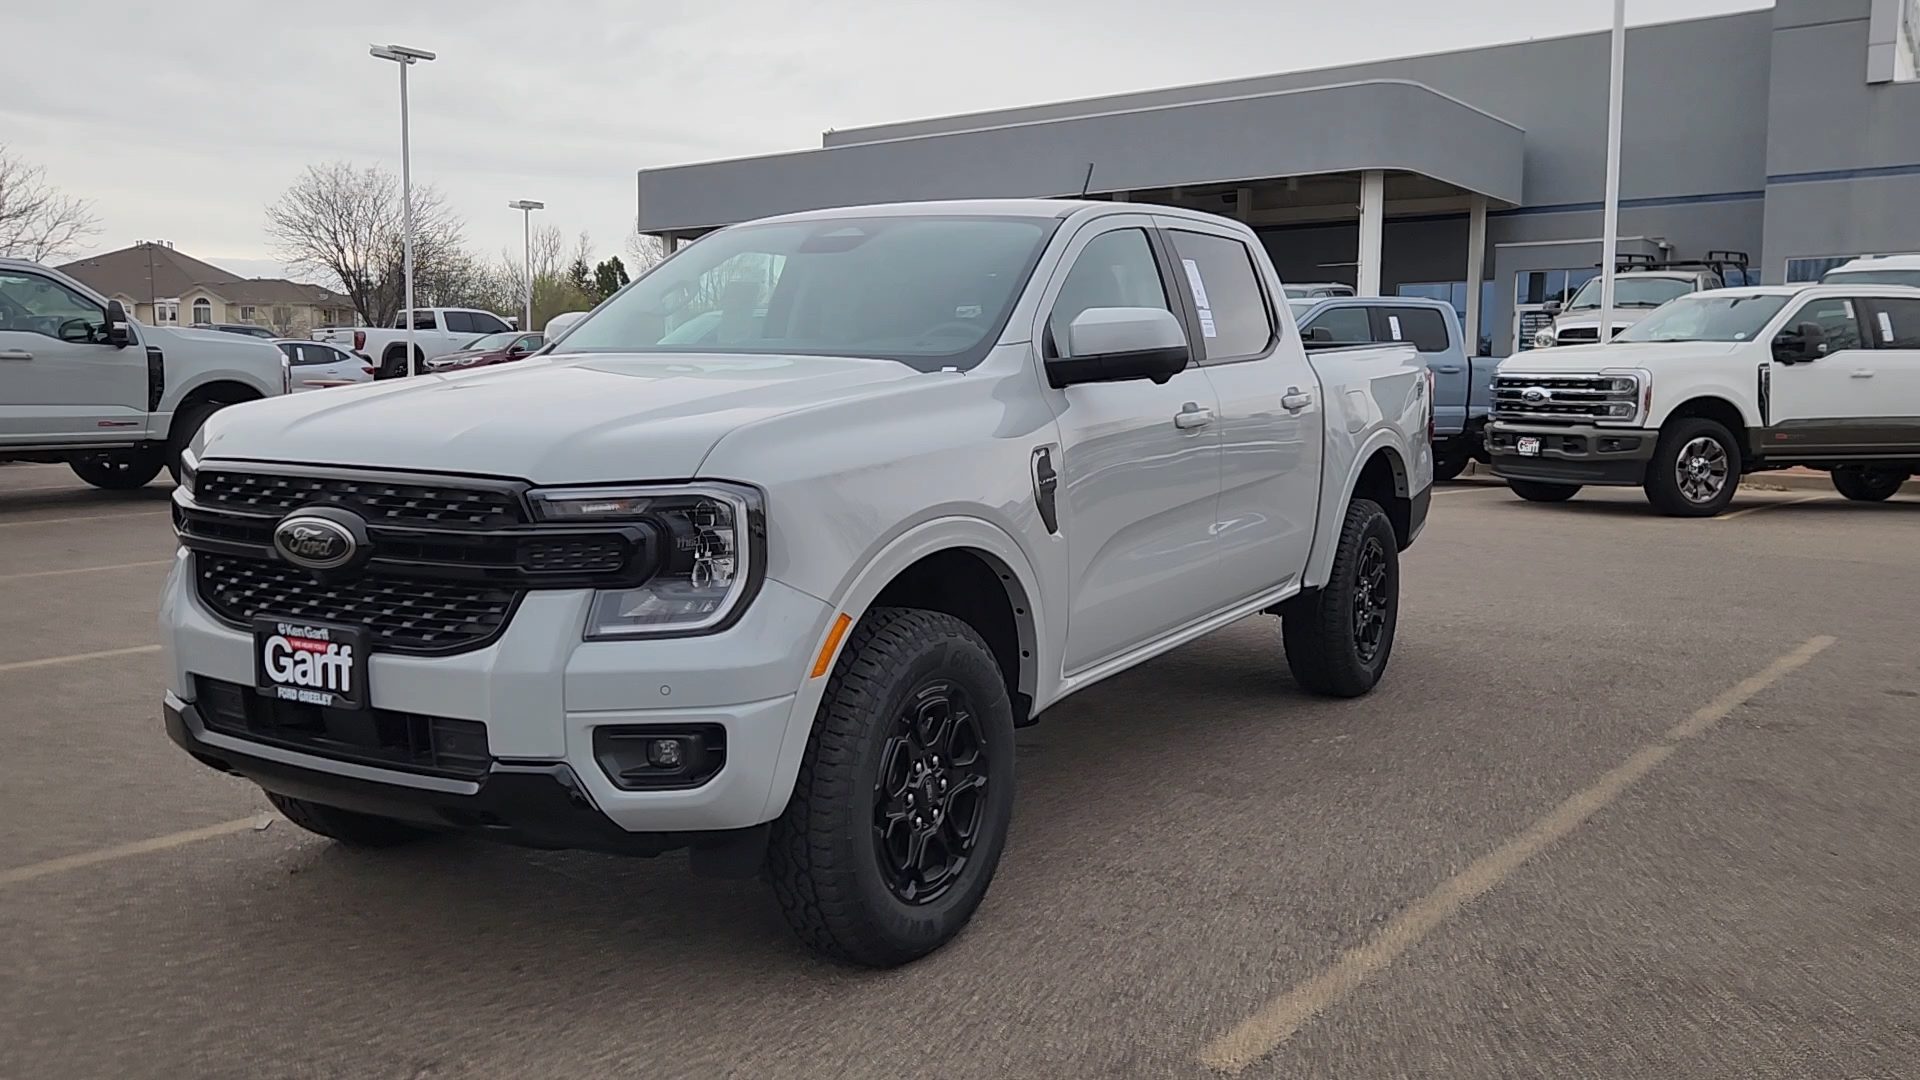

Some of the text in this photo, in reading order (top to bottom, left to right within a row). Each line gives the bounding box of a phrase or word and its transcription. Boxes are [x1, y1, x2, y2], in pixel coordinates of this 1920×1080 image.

[1517, 439, 1539, 453] Garff
[289, 527, 334, 555] Ford
[286, 624, 330, 640] Ken Garff
[264, 635, 353, 692] Garff
[277, 686, 332, 706] FORD GREELEY
